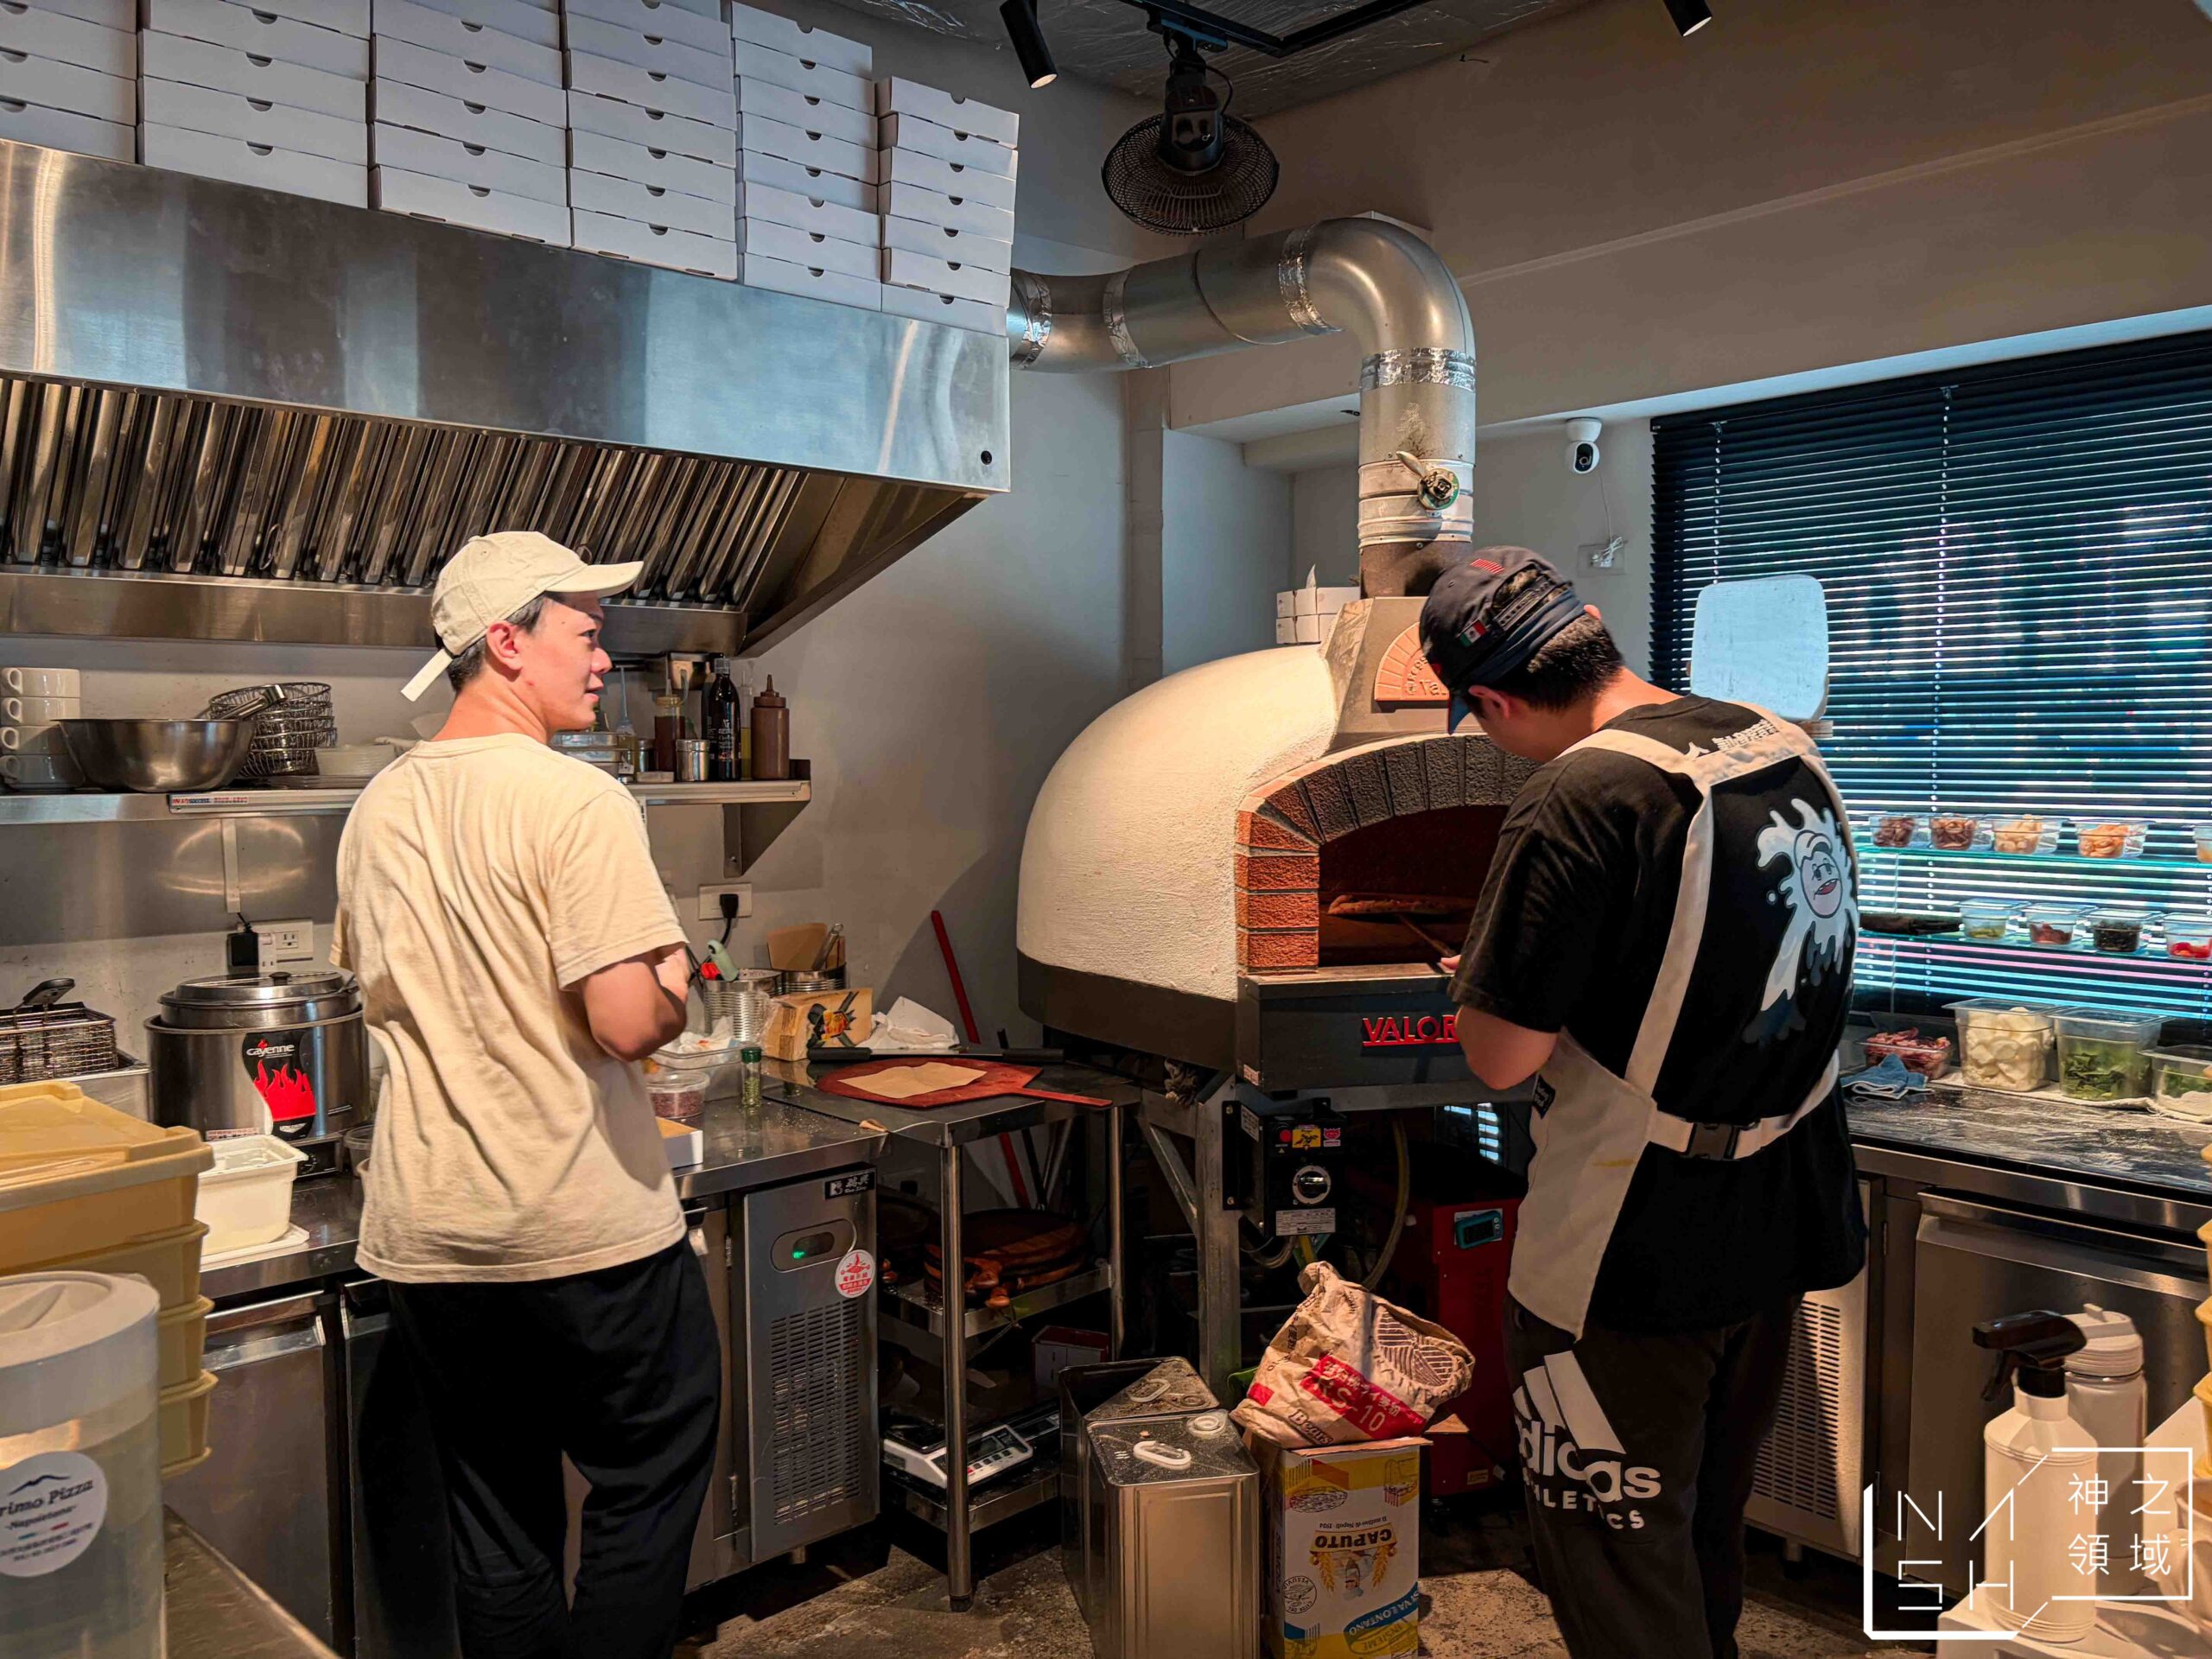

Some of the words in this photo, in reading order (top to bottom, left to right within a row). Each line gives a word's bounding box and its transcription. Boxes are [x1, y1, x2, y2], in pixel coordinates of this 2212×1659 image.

[245, 1044, 296, 1057] cayenne
[1288, 1408, 1334, 1445] Bears
[0, 1497, 44, 1517] rimo
[48, 1479, 93, 1505] Pizza
[1314, 1529, 1393, 1549] CAPUTO
